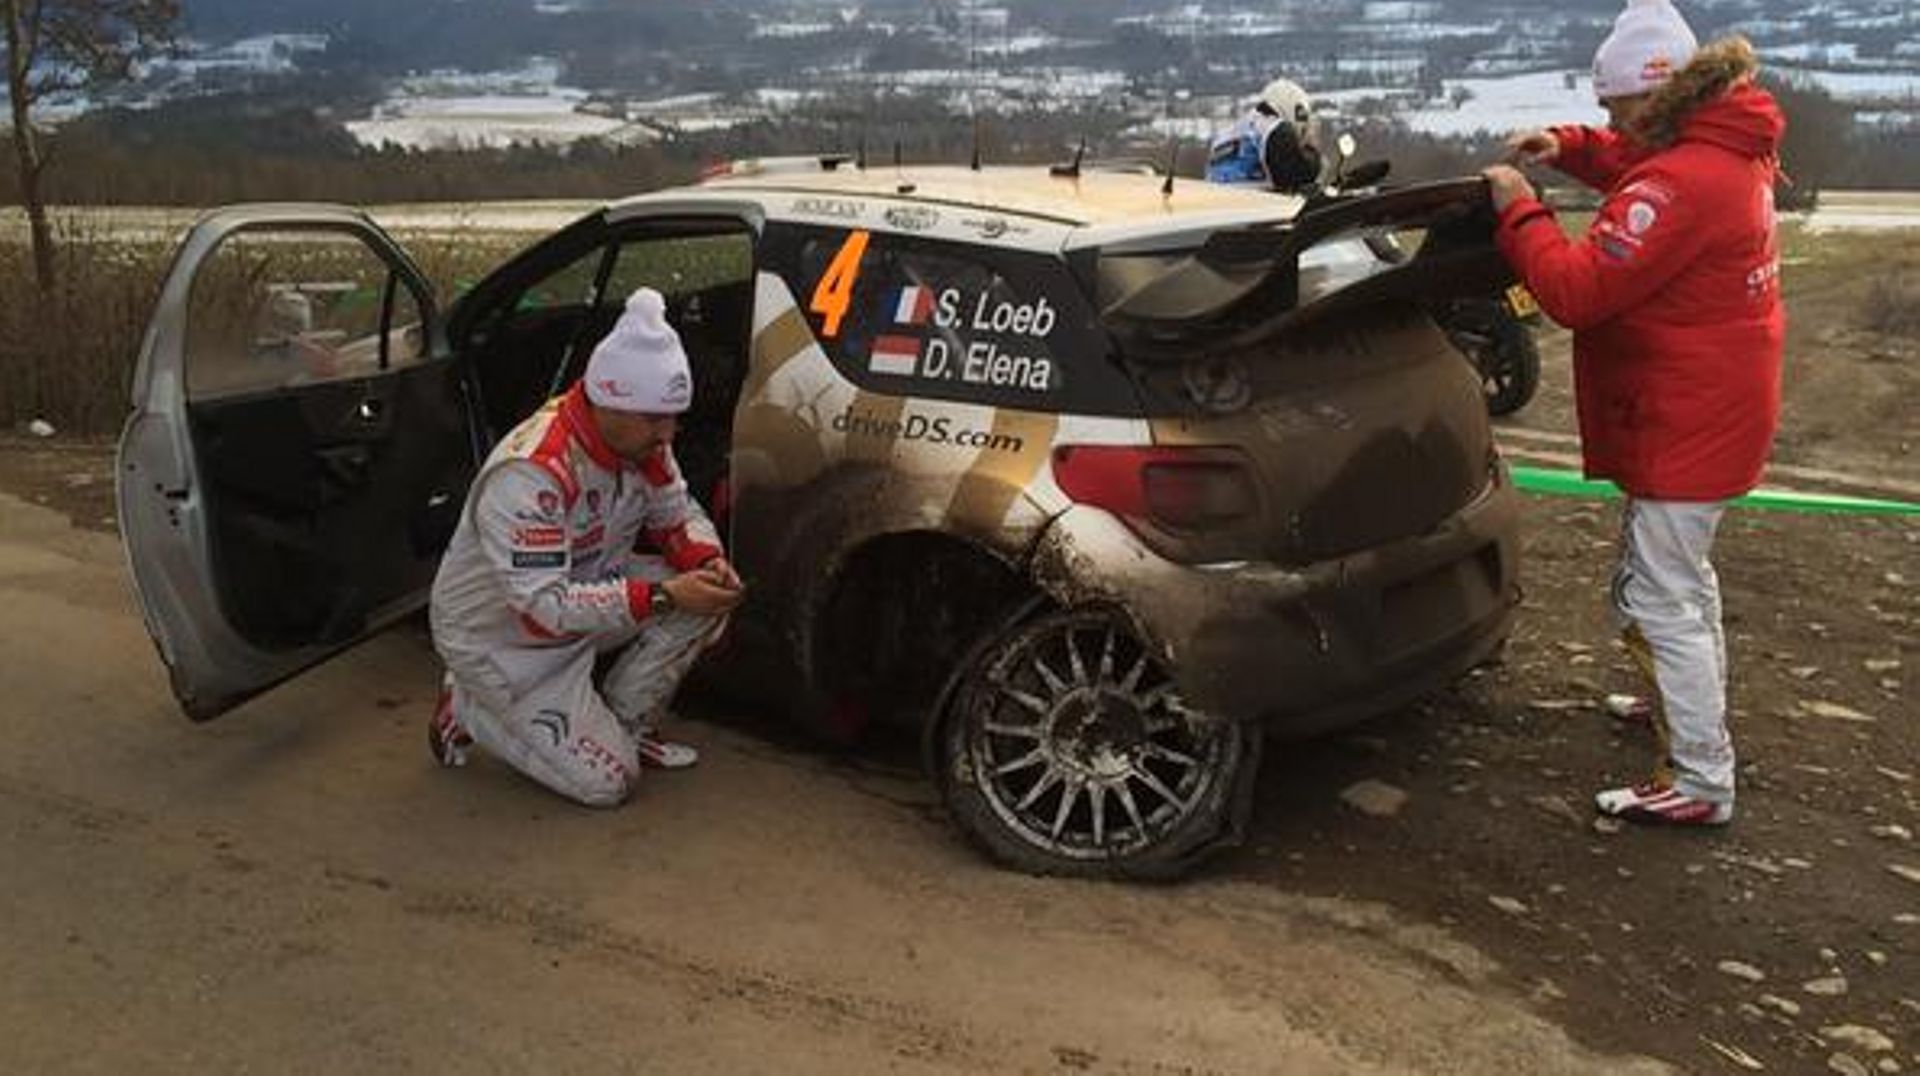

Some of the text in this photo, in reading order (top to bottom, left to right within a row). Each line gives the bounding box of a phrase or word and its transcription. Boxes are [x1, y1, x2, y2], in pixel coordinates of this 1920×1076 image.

[810, 229, 869, 336] 4
[935, 288, 1056, 337] S. Loeb
[922, 338, 1051, 391] D. Elena
[832, 405, 1024, 452] driveDS.com
